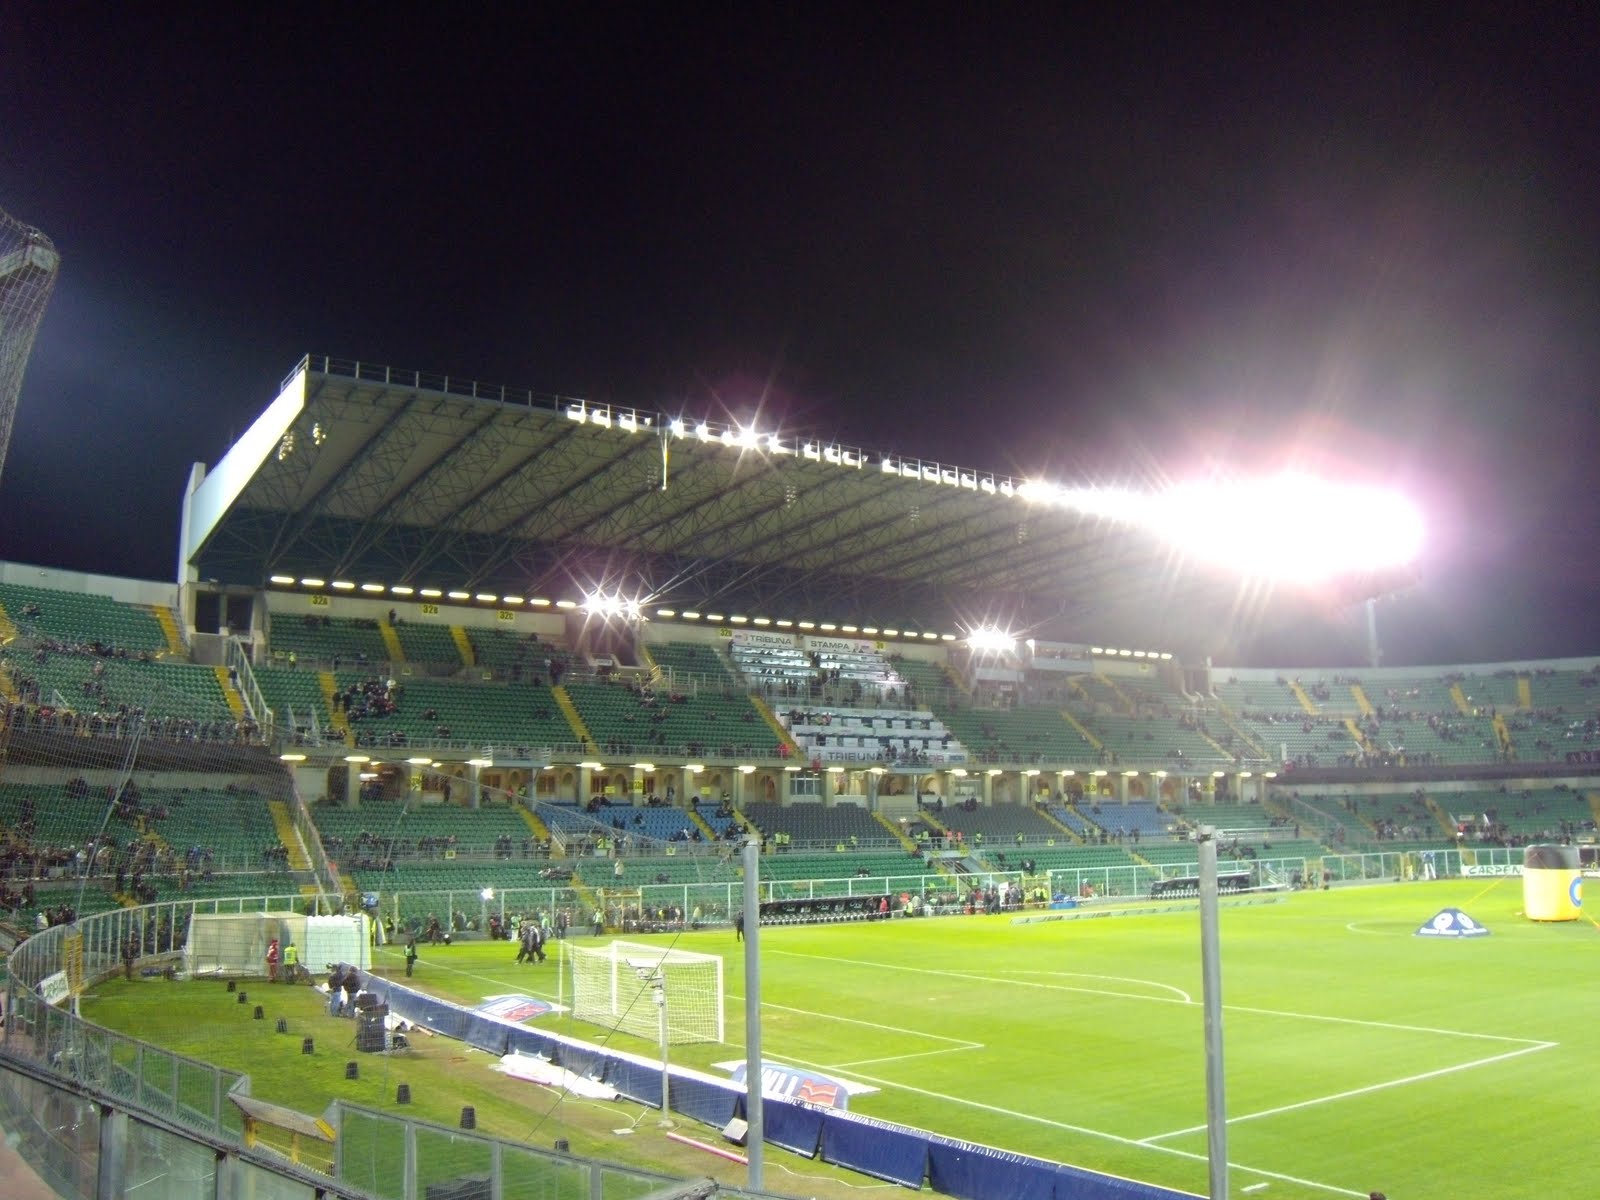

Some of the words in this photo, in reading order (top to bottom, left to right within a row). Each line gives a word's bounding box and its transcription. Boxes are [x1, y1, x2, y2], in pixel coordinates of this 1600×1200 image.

[312, 595, 329, 606] 32A
[810, 640, 850, 651] STAMPA
[827, 751, 884, 761] TRIBUNA
